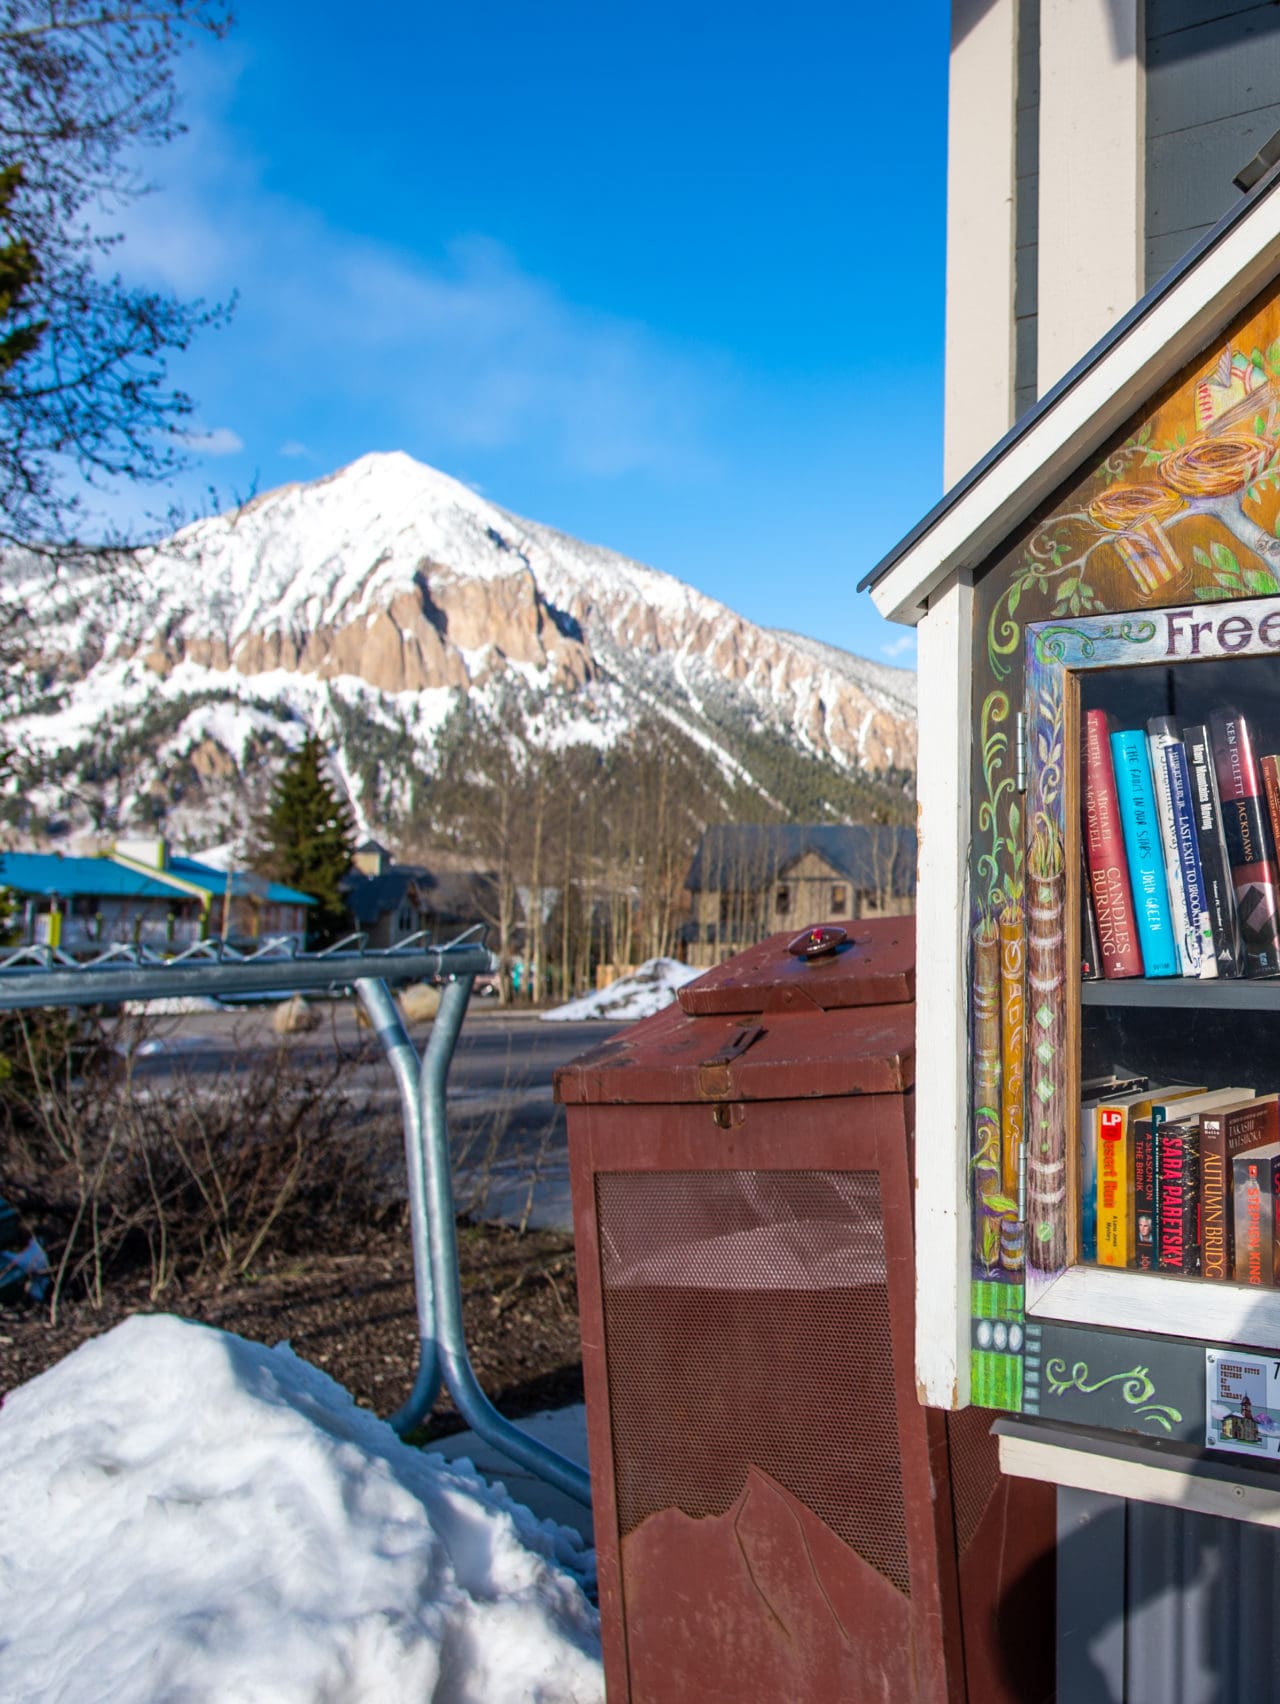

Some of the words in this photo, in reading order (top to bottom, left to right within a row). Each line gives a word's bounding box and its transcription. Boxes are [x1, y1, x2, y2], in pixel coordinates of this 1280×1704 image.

[1226, 721, 1237, 745] KEN
[1229, 747, 1244, 796] FOLLETT
[1086, 784, 1101, 851] McDOWELL
[1098, 789, 1112, 841] MICHAEL
[1180, 815, 1191, 839] LAST
[1237, 801, 1254, 862] JACKDAWS
[1183, 840, 1195, 866] EXIT
[1186, 868, 1197, 882] TO
[1141, 869, 1155, 894] JOHN
[1093, 868, 1115, 957] BURNING
[1107, 866, 1130, 954] CANDLES
[1145, 897, 1162, 932] GREEN
[1102, 1113, 1122, 1126] LP
[1162, 1137, 1183, 1180] SARA
[1204, 1150, 1222, 1222] AUTUMN
[1162, 1185, 1183, 1267] PARETSKY
[1247, 1188, 1260, 1248] STEPHEN
[1205, 1226, 1224, 1278] BRIDG
[1249, 1252, 1262, 1285] KING
